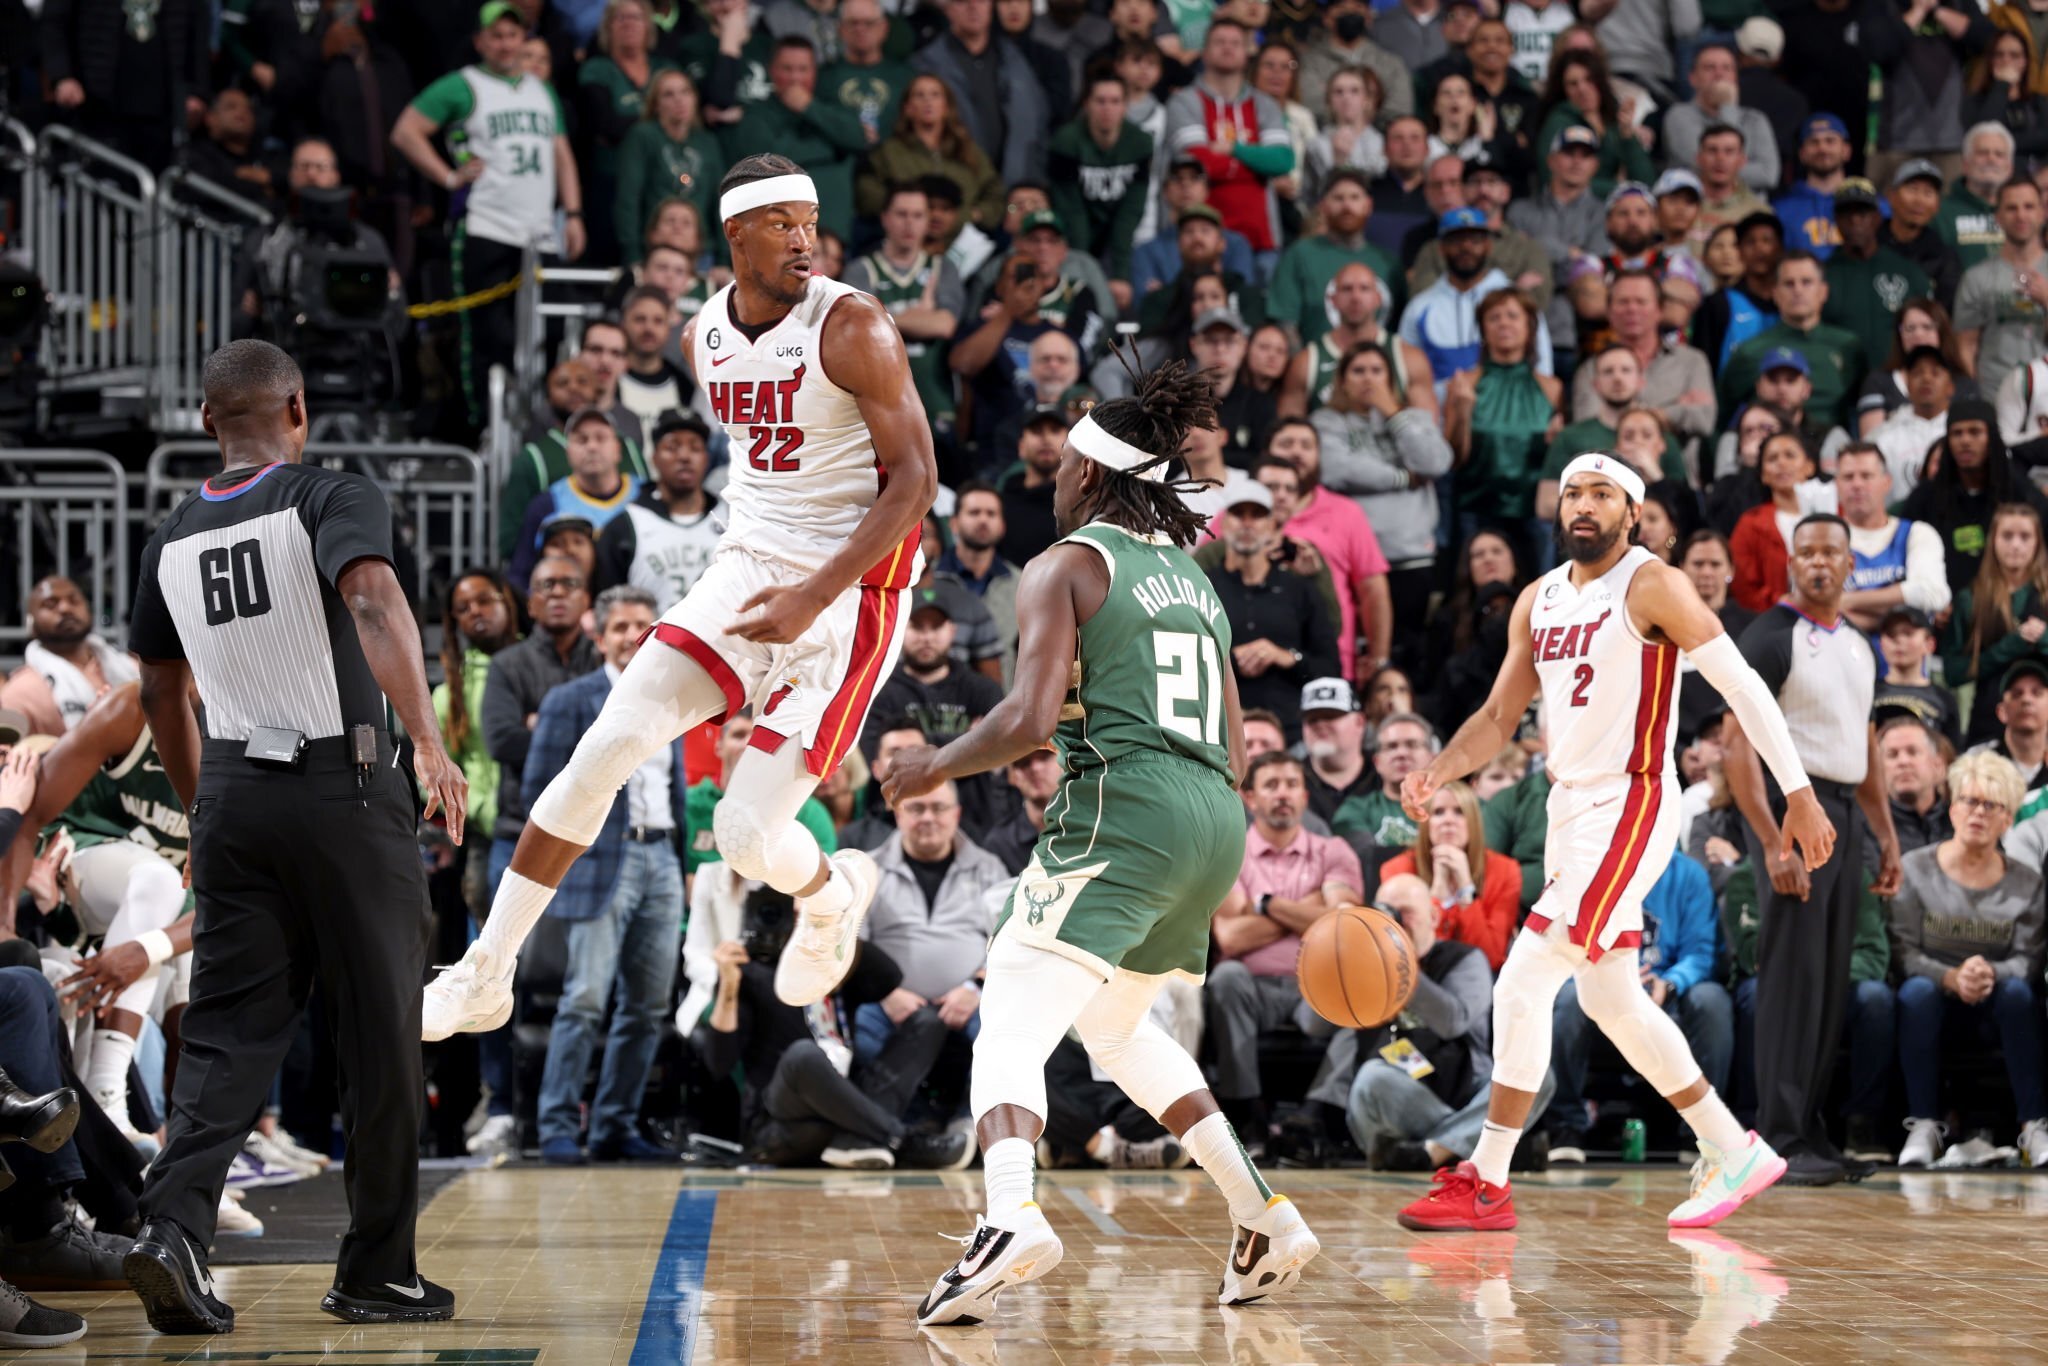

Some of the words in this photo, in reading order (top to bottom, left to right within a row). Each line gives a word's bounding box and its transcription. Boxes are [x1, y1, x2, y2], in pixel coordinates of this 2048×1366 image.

[487, 109, 554, 139] BUCKS
[508, 144, 542, 175] 34
[776, 346, 804, 358] UKG
[708, 360, 807, 425] HEAT
[748, 425, 805, 473] 22
[198, 537, 272, 627] 60
[645, 543, 713, 577] BUCK
[1131, 572, 1221, 627] HOLIDAY
[1531, 606, 1612, 664] HEAT
[1152, 630, 1222, 746] 21
[1569, 662, 1595, 708] 2
